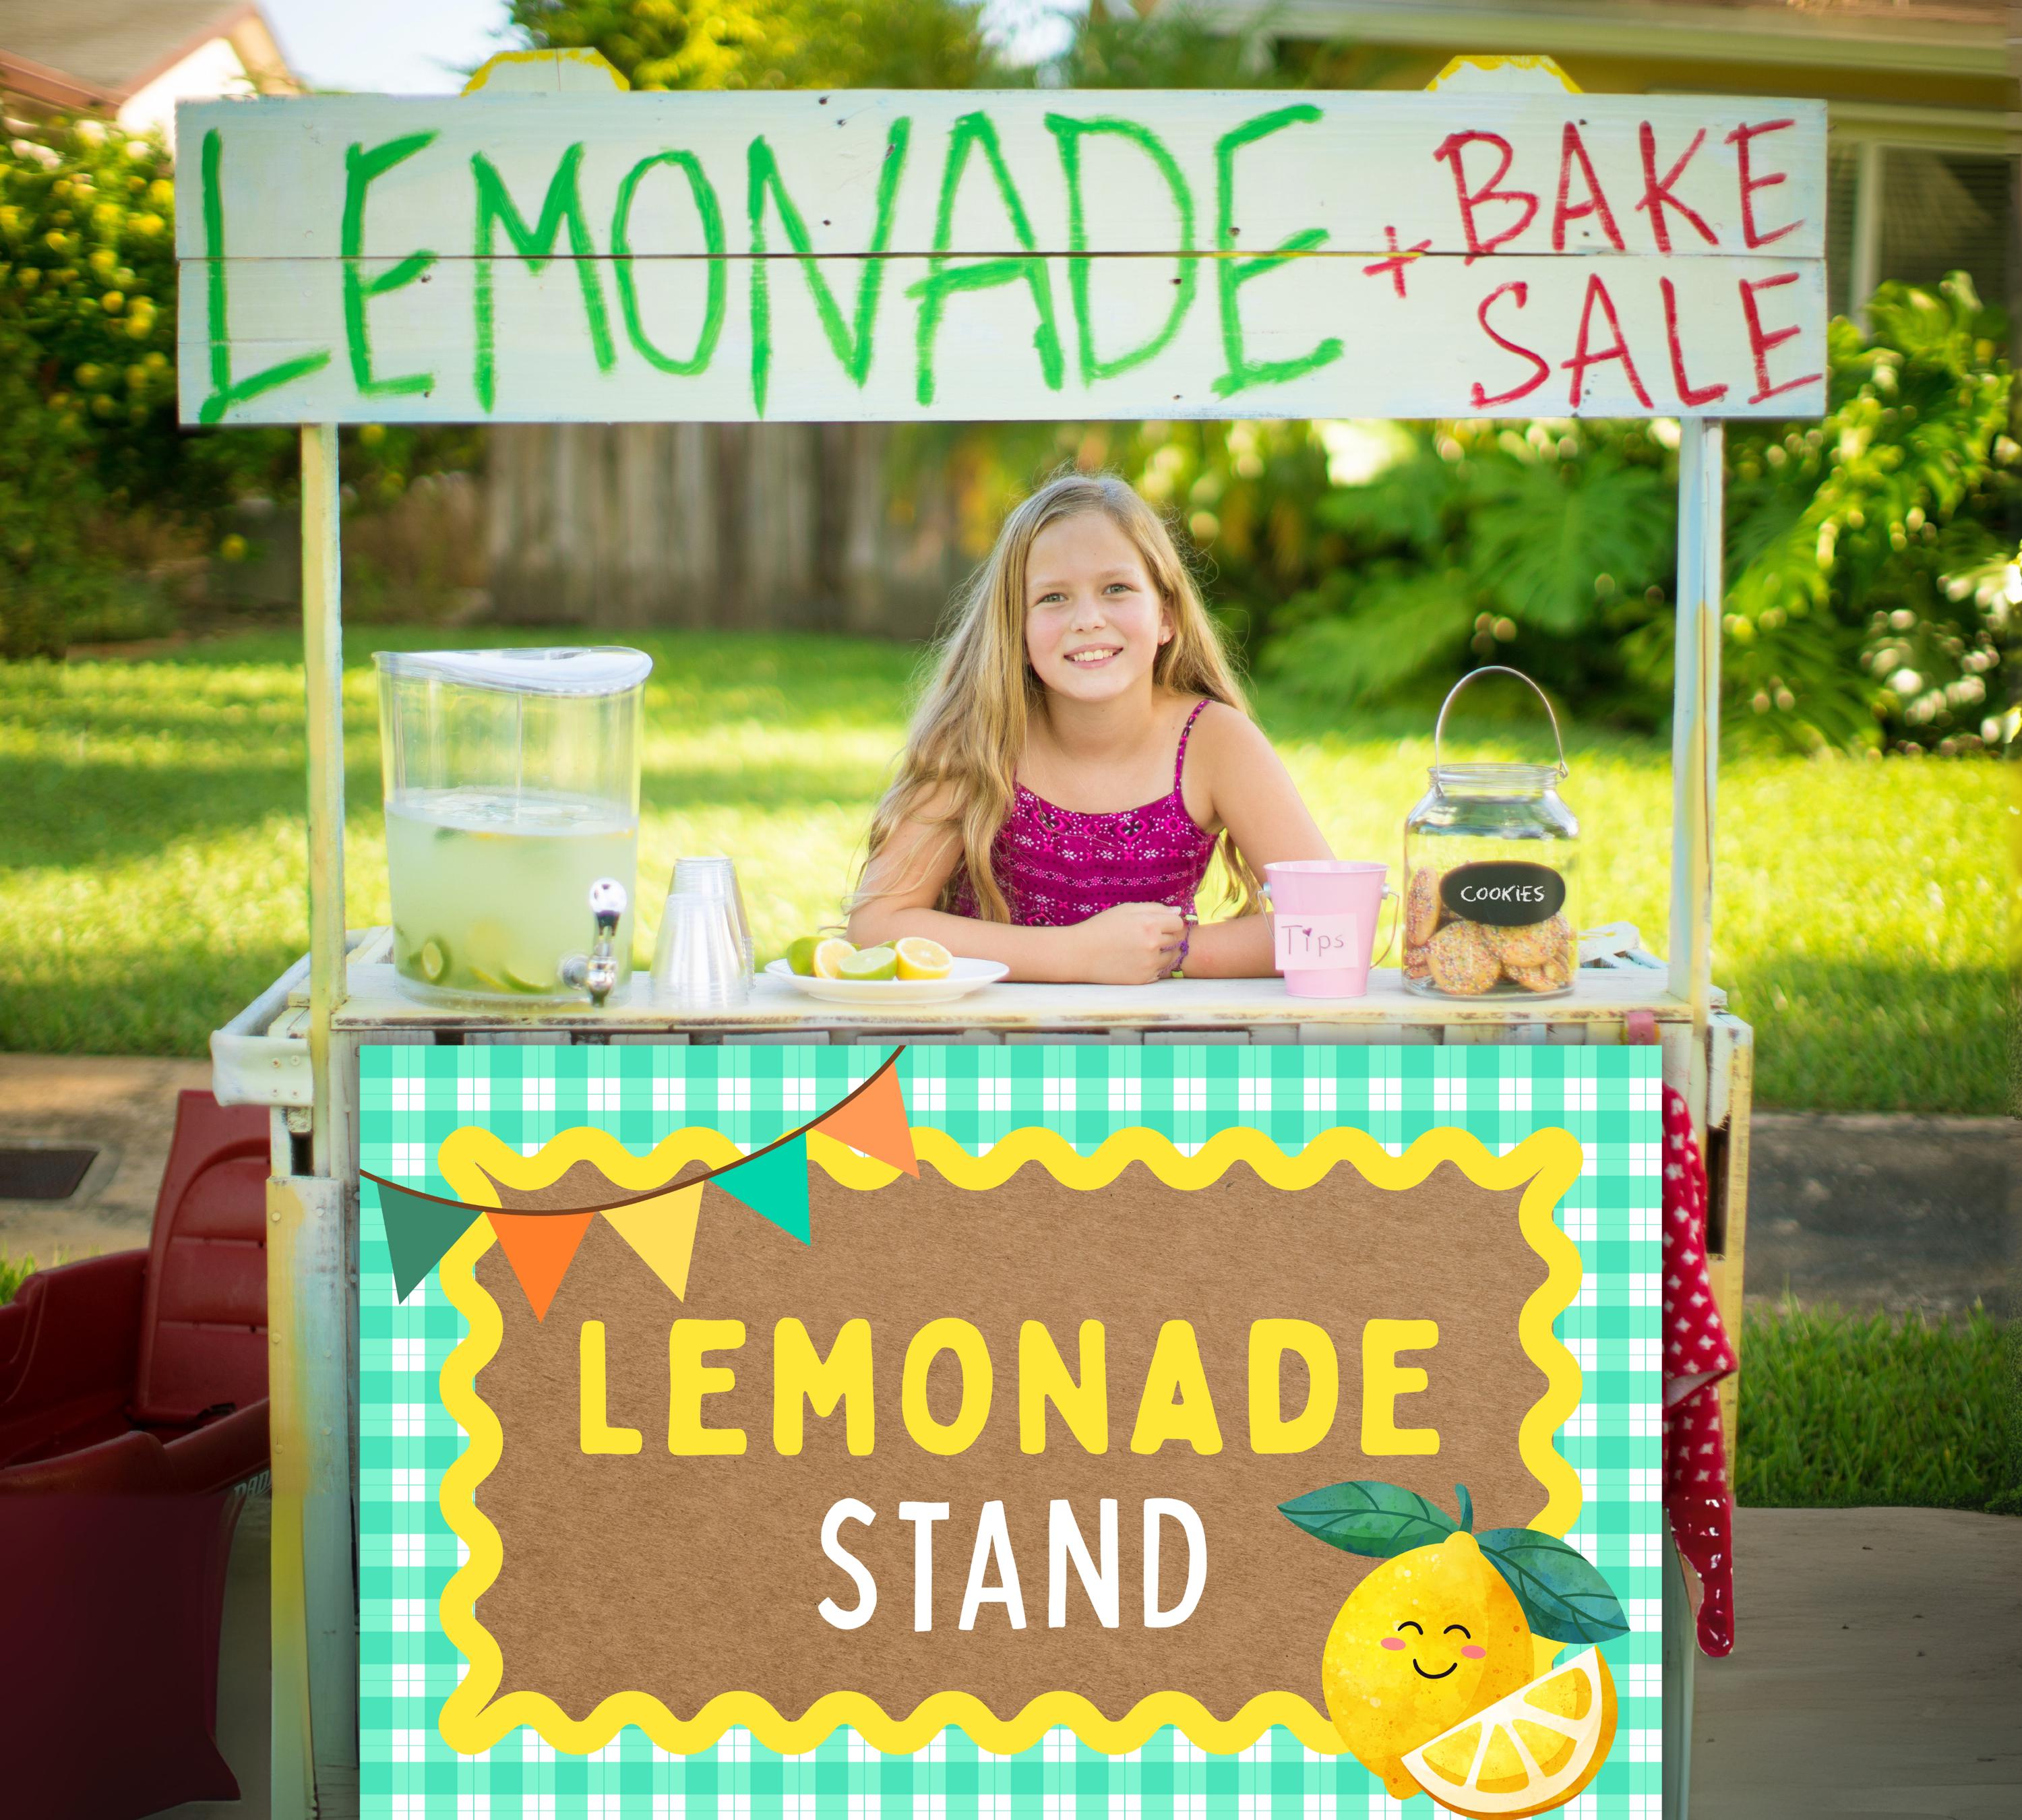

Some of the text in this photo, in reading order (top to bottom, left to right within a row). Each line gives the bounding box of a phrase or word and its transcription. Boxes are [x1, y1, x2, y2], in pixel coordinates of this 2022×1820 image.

[1432, 117, 1808, 266] BAKE
[198, 103, 1345, 423] LEMONADE
[1470, 272, 1824, 409] SALE
[1281, 924, 1345, 957] Tips
[579, 1316, 1441, 1457] LEMONADE
[818, 1497, 1208, 1633] STAND
